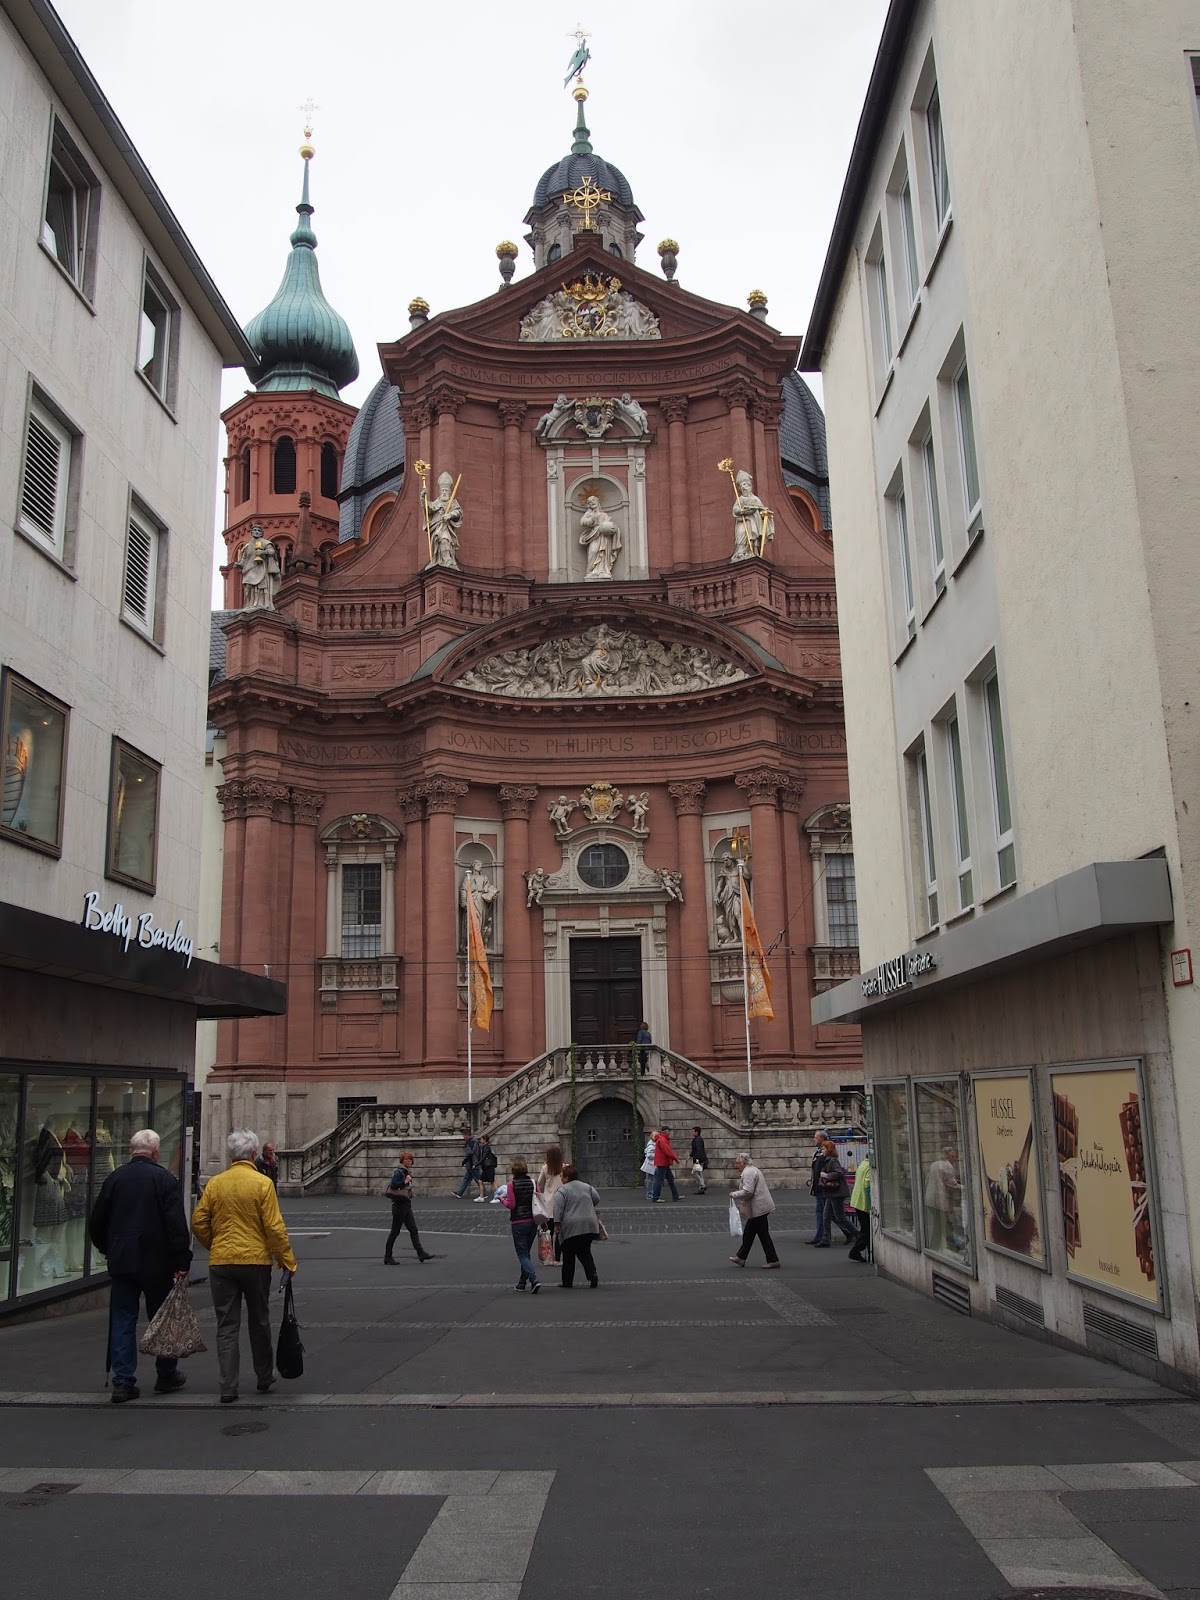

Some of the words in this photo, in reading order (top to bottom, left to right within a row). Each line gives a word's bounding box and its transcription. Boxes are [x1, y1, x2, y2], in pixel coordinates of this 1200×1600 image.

[448, 730, 529, 753] JOANNES
[546, 737, 634, 753] PHILIPPUS
[653, 724, 751, 750] EPISCOPUS
[83, 891, 131, 953] Betty
[138, 913, 193, 969] Barclay
[877, 955, 907, 995] HUSSEL
[990, 1098, 1017, 1120] HUSSEL
